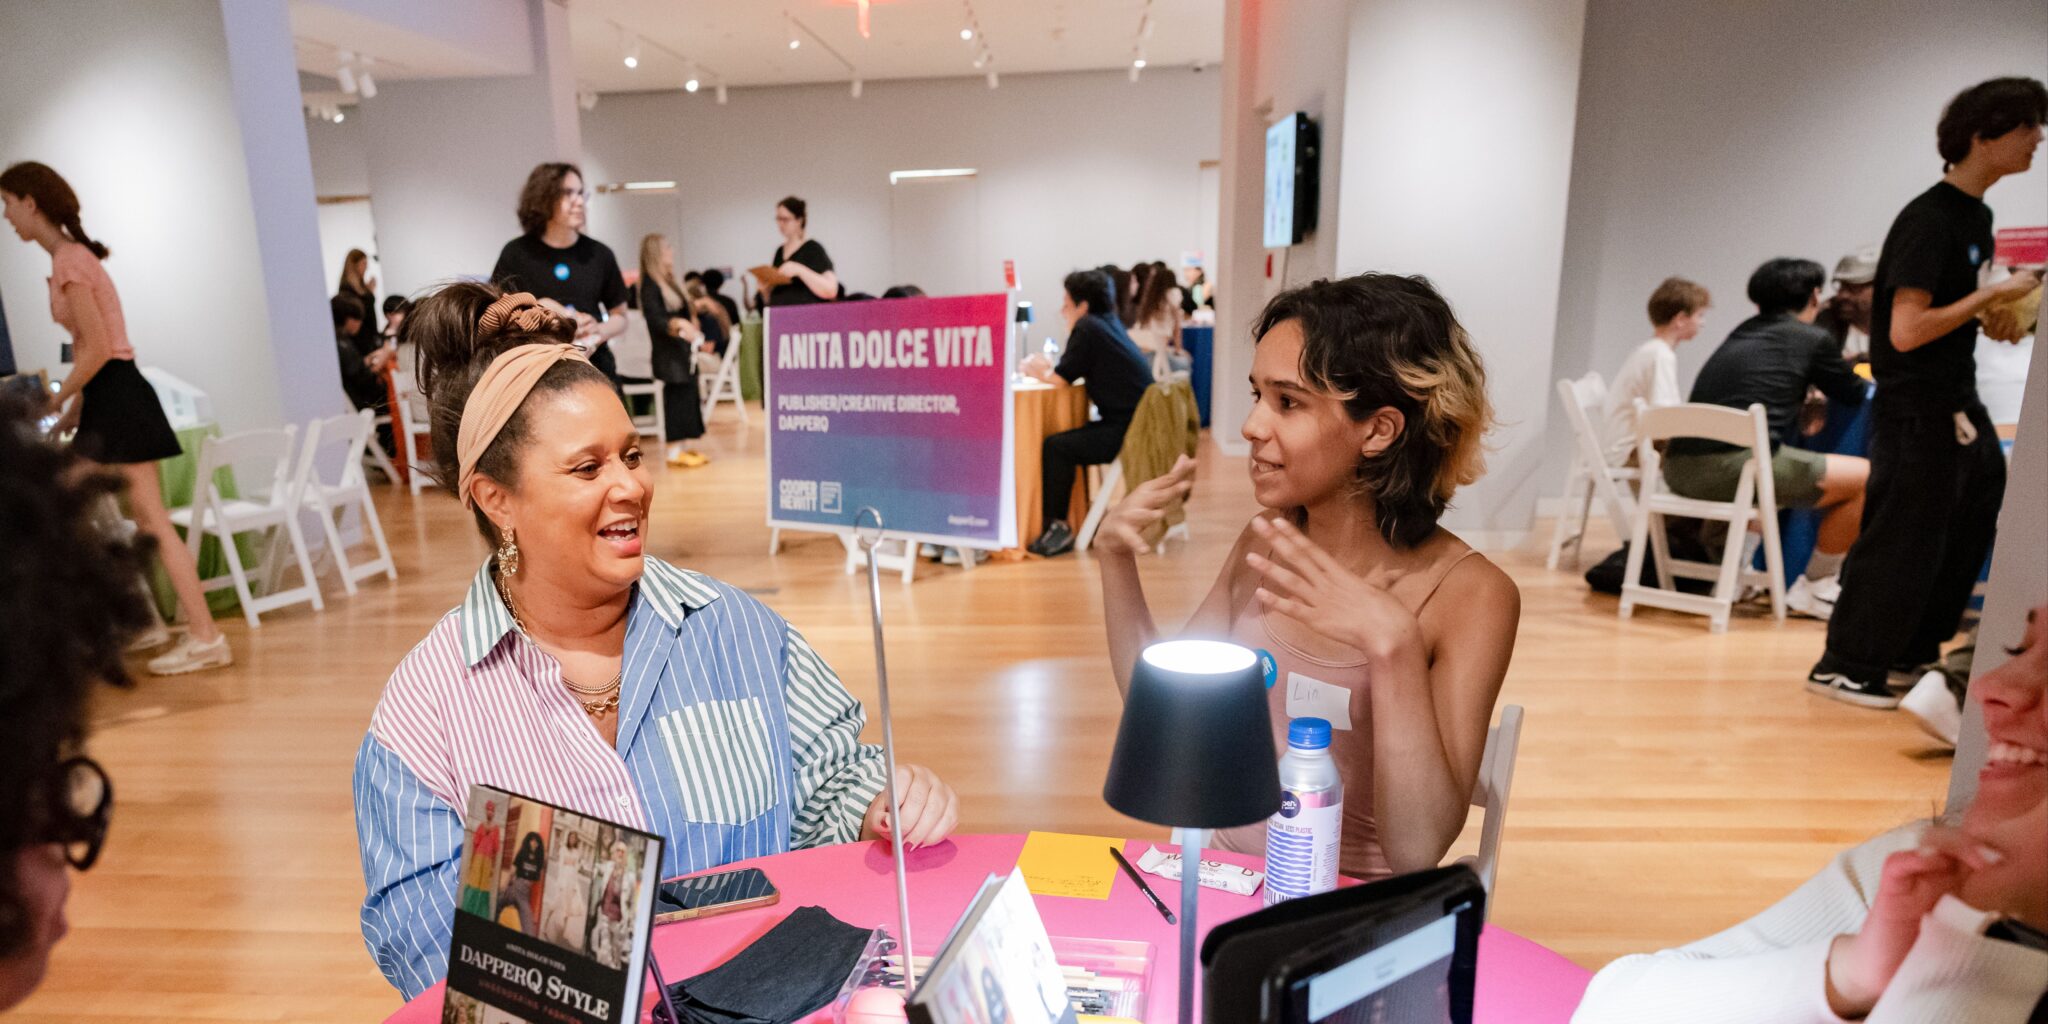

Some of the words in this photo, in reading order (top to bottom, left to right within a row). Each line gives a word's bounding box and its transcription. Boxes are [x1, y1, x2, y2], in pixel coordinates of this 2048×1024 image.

[778, 332, 844, 369] ANITA
[848, 329, 929, 368] DOLCE
[932, 325, 993, 367] VITA
[777, 394, 895, 413] PUBLISHER/CREATIVE
[896, 395, 960, 415] DIRECTOR,
[777, 415, 829, 433] DAPPERQ
